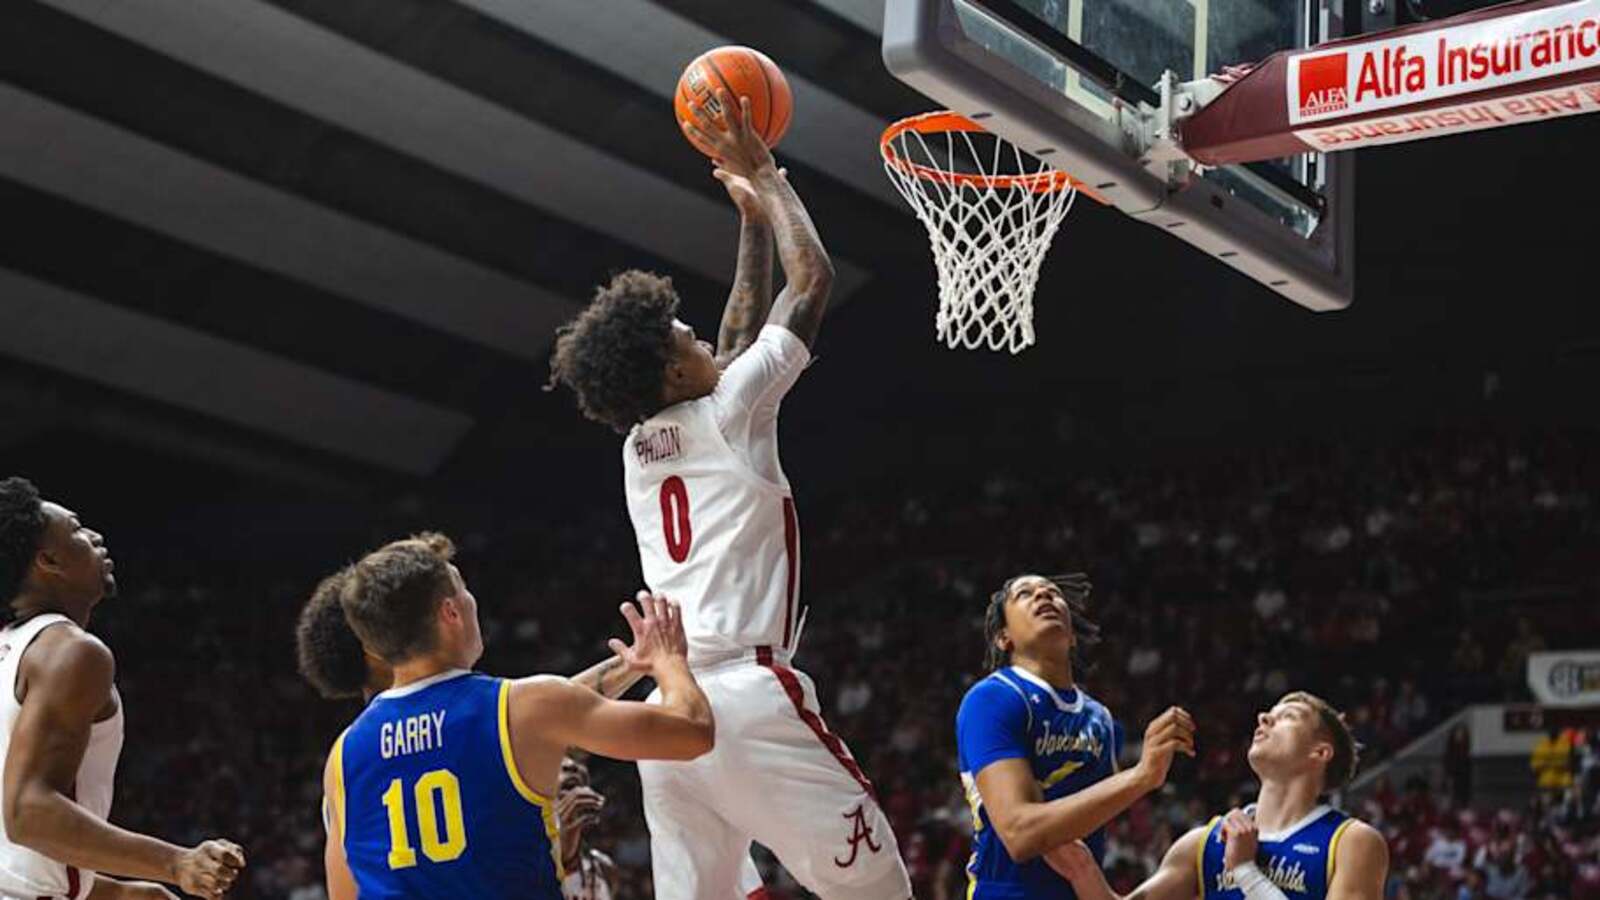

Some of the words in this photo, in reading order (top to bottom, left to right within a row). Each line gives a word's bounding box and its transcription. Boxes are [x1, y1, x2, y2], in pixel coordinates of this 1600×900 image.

[1355, 45, 1425, 102] Alfa
[1437, 20, 1600, 86] Insuranc
[660, 475, 692, 564] 0
[380, 709, 446, 759] GARRY
[382, 769, 467, 870] 10
